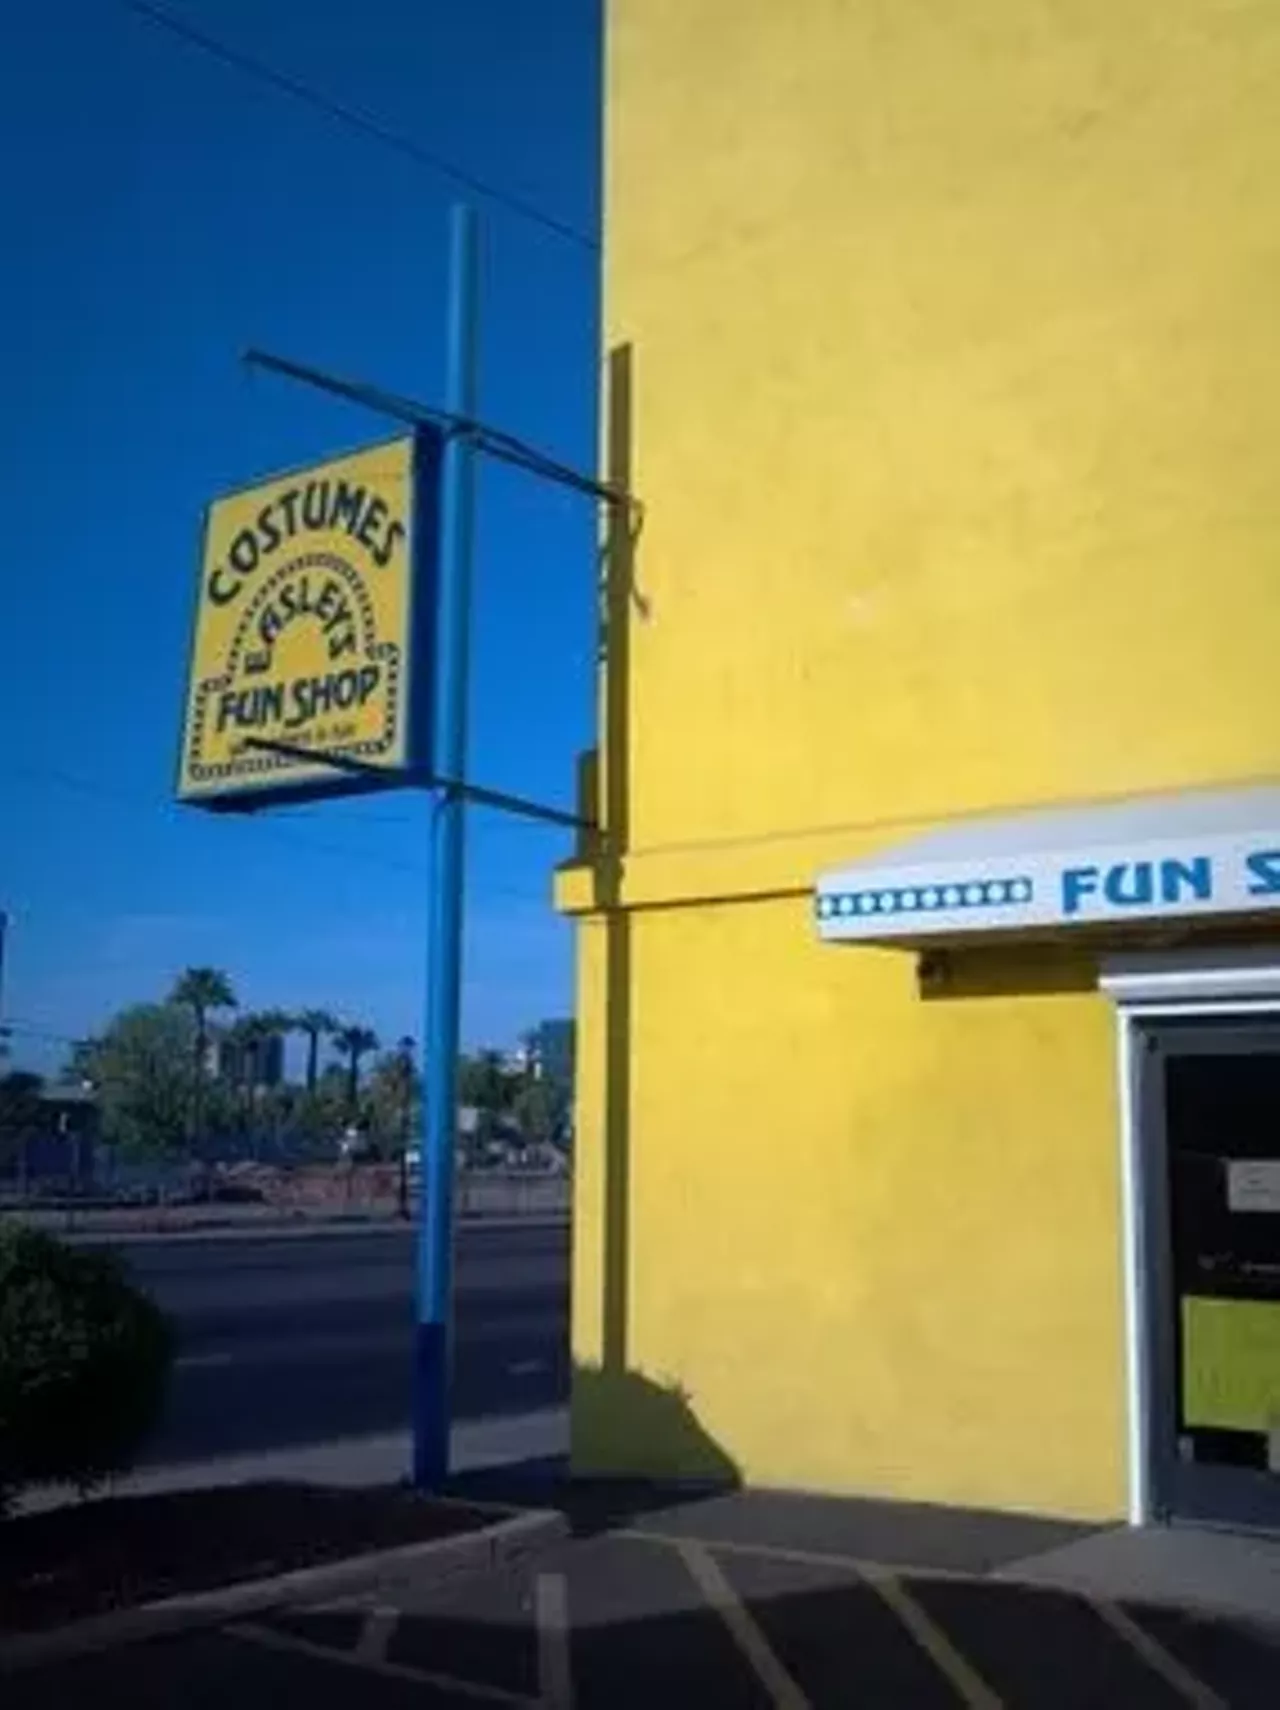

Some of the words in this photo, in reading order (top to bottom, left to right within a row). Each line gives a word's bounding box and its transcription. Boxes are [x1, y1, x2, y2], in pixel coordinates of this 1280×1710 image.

[208, 481, 405, 606] COSTUMES
[217, 683, 285, 732] FUN
[286, 667, 379, 729] SHOP
[1061, 856, 1212, 914] FUN
